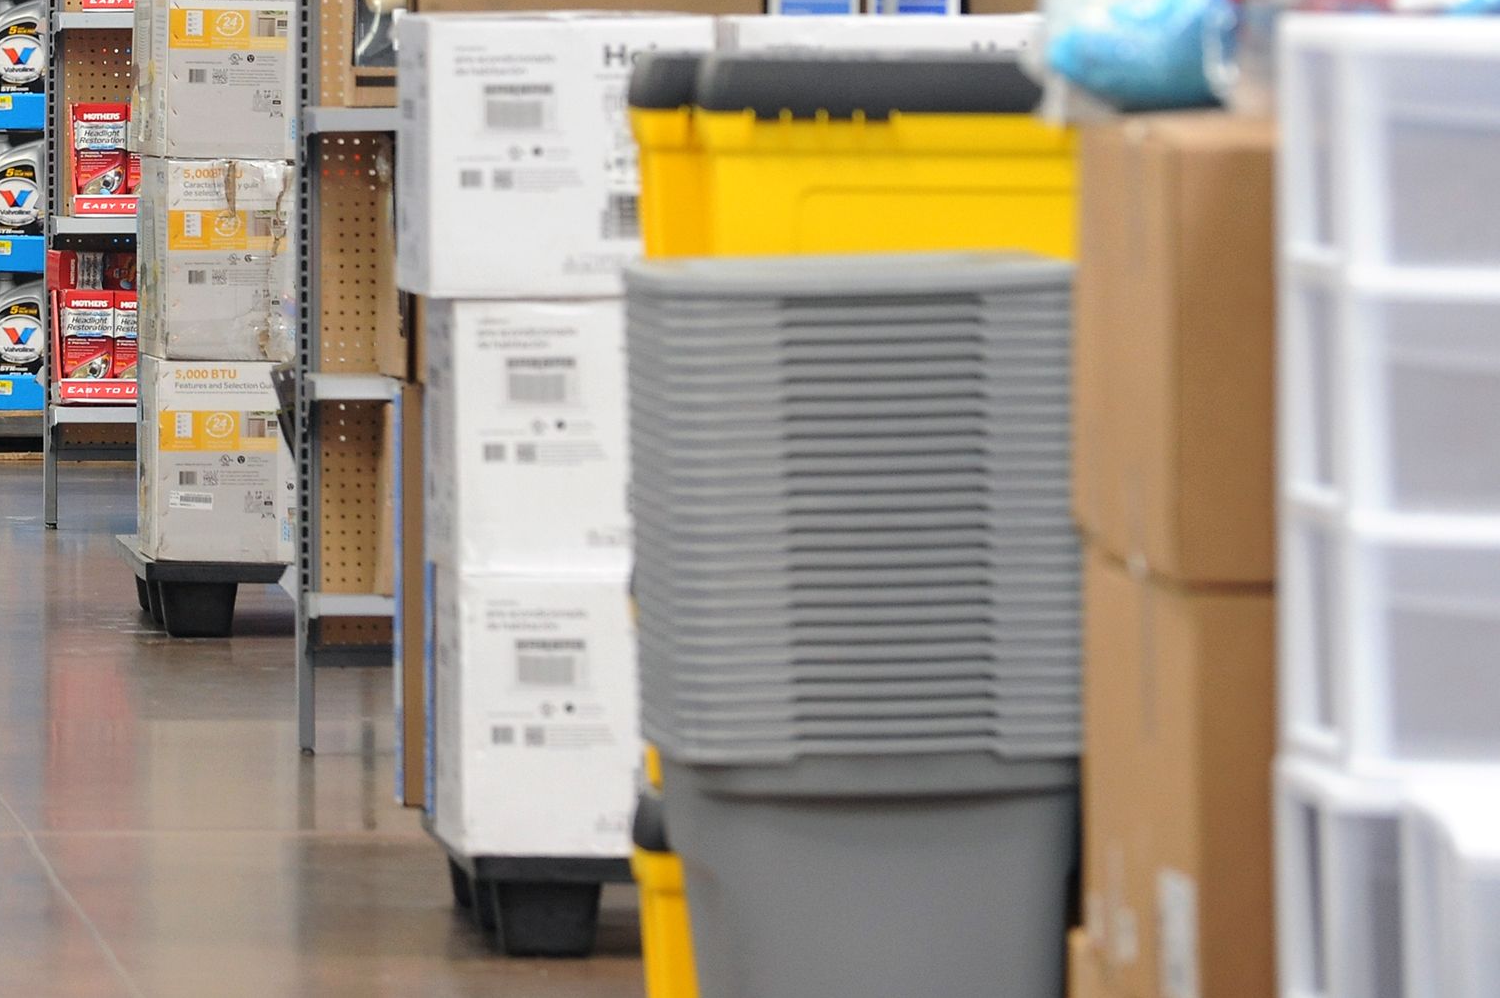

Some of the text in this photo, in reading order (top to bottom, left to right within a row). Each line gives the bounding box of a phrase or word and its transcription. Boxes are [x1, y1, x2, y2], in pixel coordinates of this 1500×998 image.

[222, 16, 238, 28] 24
[79, 136, 125, 144] Restoration
[71, 317, 107, 325] Headlight
[67, 324, 112, 332] Restoration
[175, 369, 237, 380] 5,000 BTU
[67, 386, 101, 394] EASY
[175, 382, 207, 390] Features
[224, 382, 259, 390] Selection
[211, 417, 228, 429] 24
